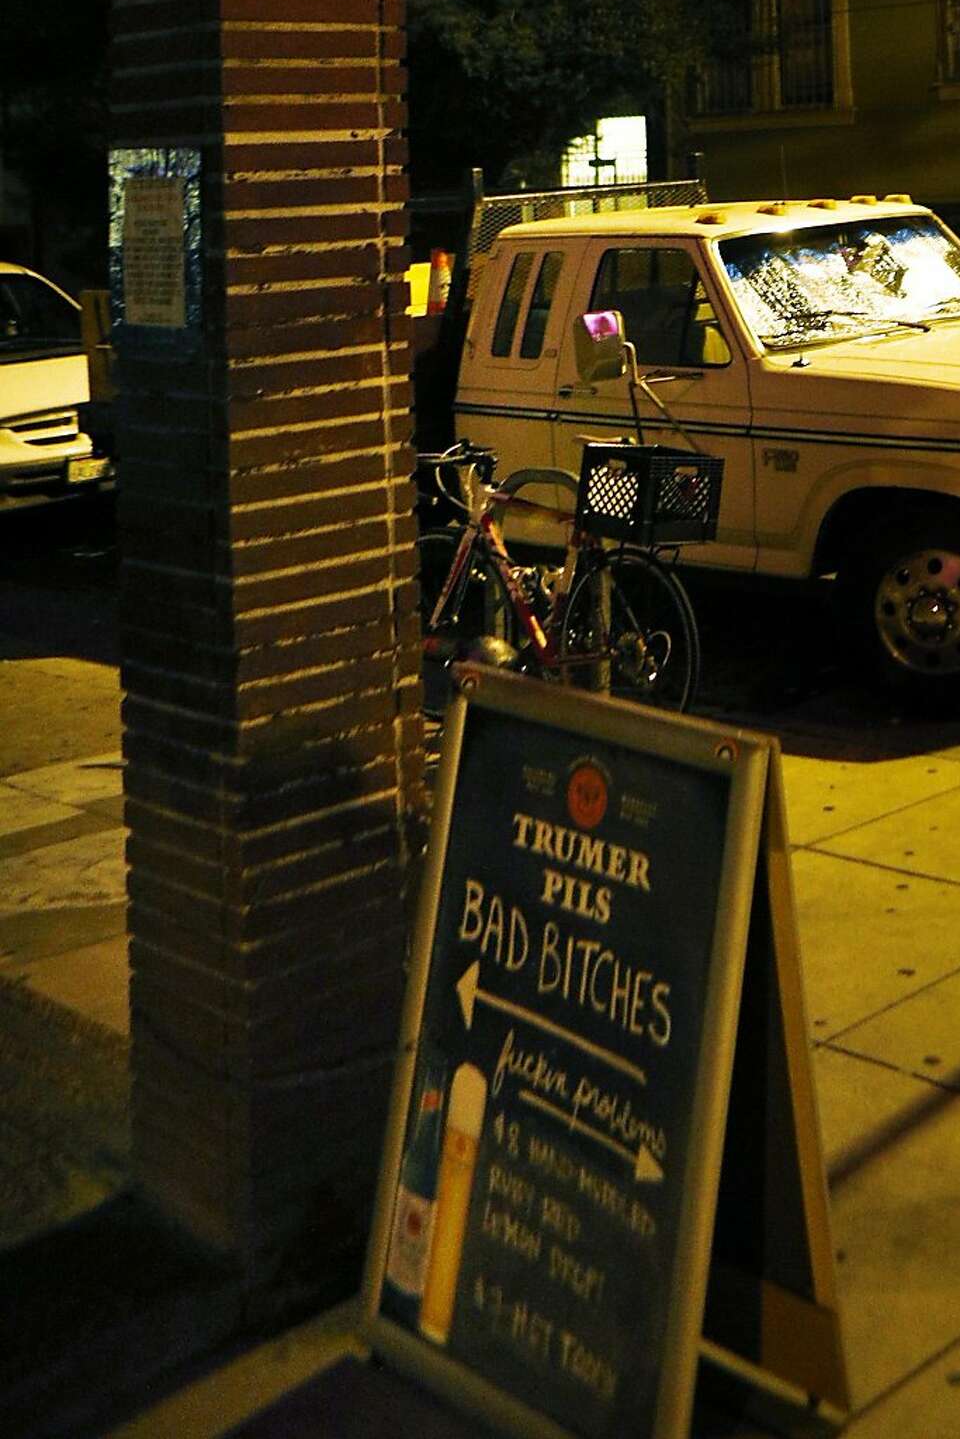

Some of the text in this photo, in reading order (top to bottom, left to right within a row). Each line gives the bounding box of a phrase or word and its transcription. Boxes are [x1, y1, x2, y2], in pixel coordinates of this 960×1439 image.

[512, 813, 652, 891] TRUMER
[540, 868, 613, 924] PILS
[458, 878, 673, 1047] BAD BITCHES
